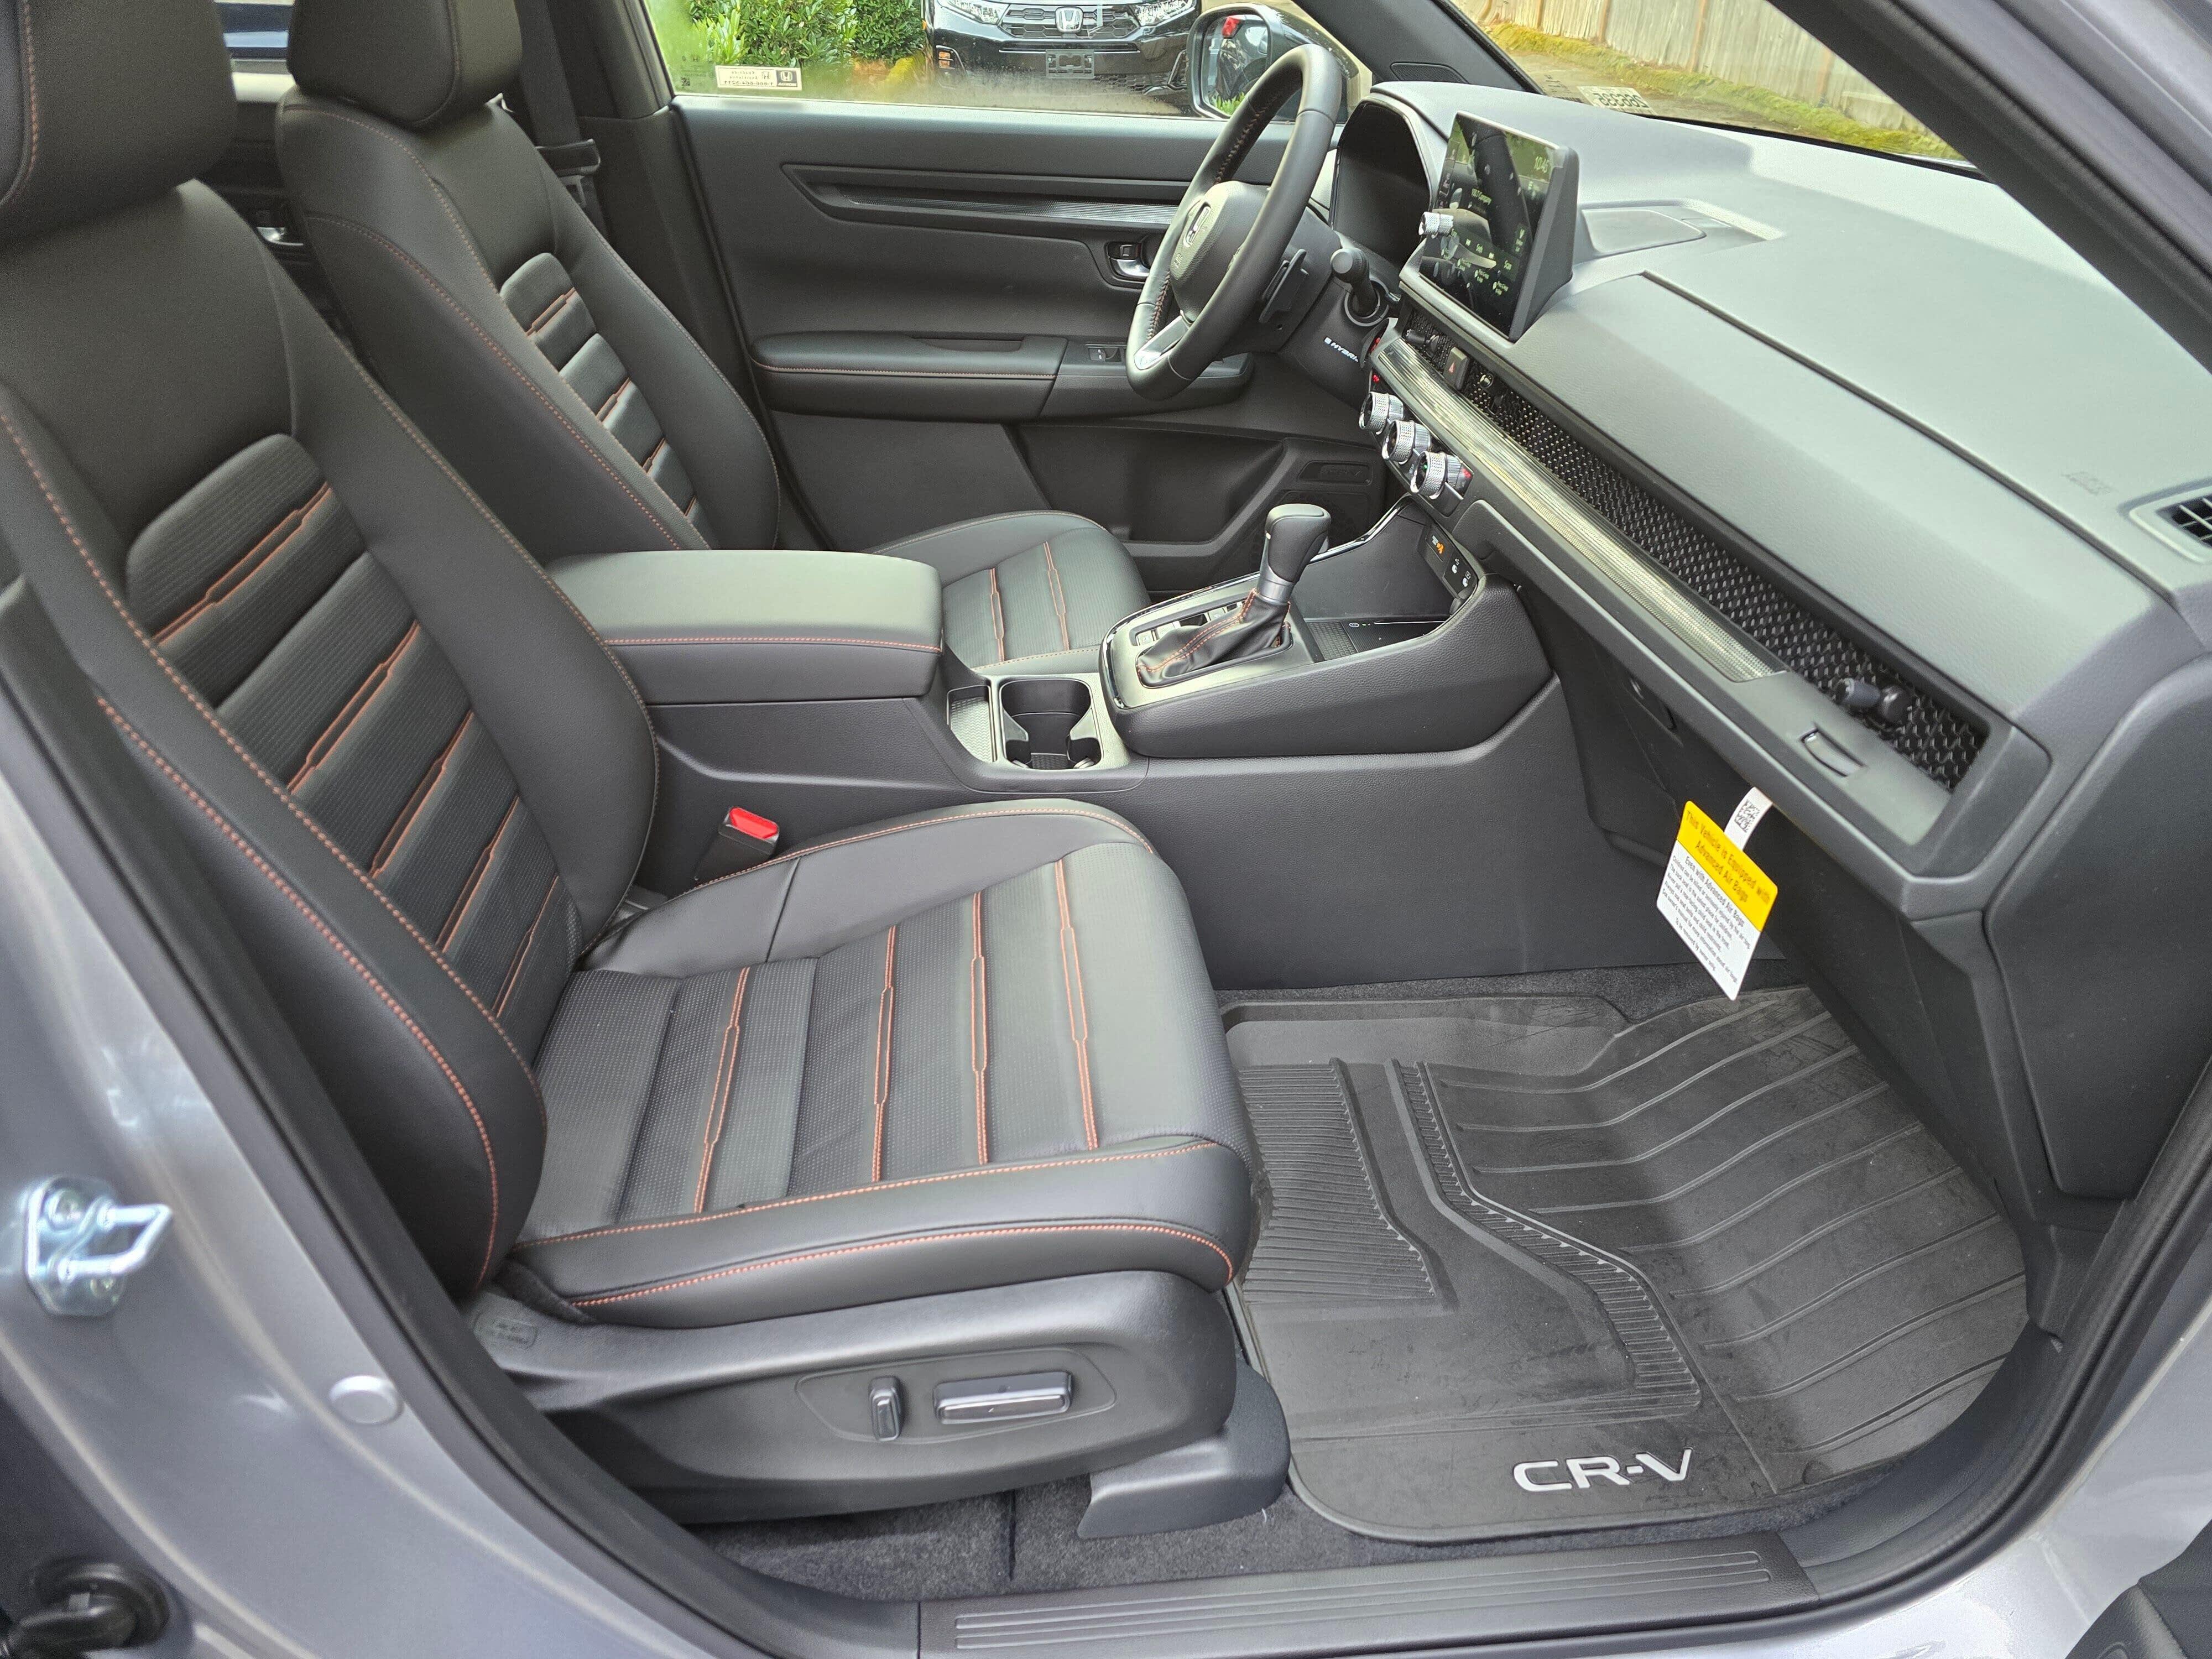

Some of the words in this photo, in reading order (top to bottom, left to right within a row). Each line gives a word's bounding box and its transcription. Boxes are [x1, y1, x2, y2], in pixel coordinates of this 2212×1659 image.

[1684, 809, 1699, 830] This
[1698, 822, 1722, 853] Vehicle
[1720, 846, 1728, 860] is
[1726, 853, 1757, 892] Equipped
[1755, 883, 1772, 906] with
[1684, 855, 1696, 872] Even
[1694, 867, 1705, 883] with
[1704, 877, 1726, 906] Advanced
[1724, 900, 1734, 915] Air
[1731, 909, 1745, 929] Bags
[1694, 838, 1724, 876] Advanced
[1722, 868, 1734, 886] Air
[1731, 879, 1750, 905] Bags
[1513, 1448, 1693, 1492] CR-V
